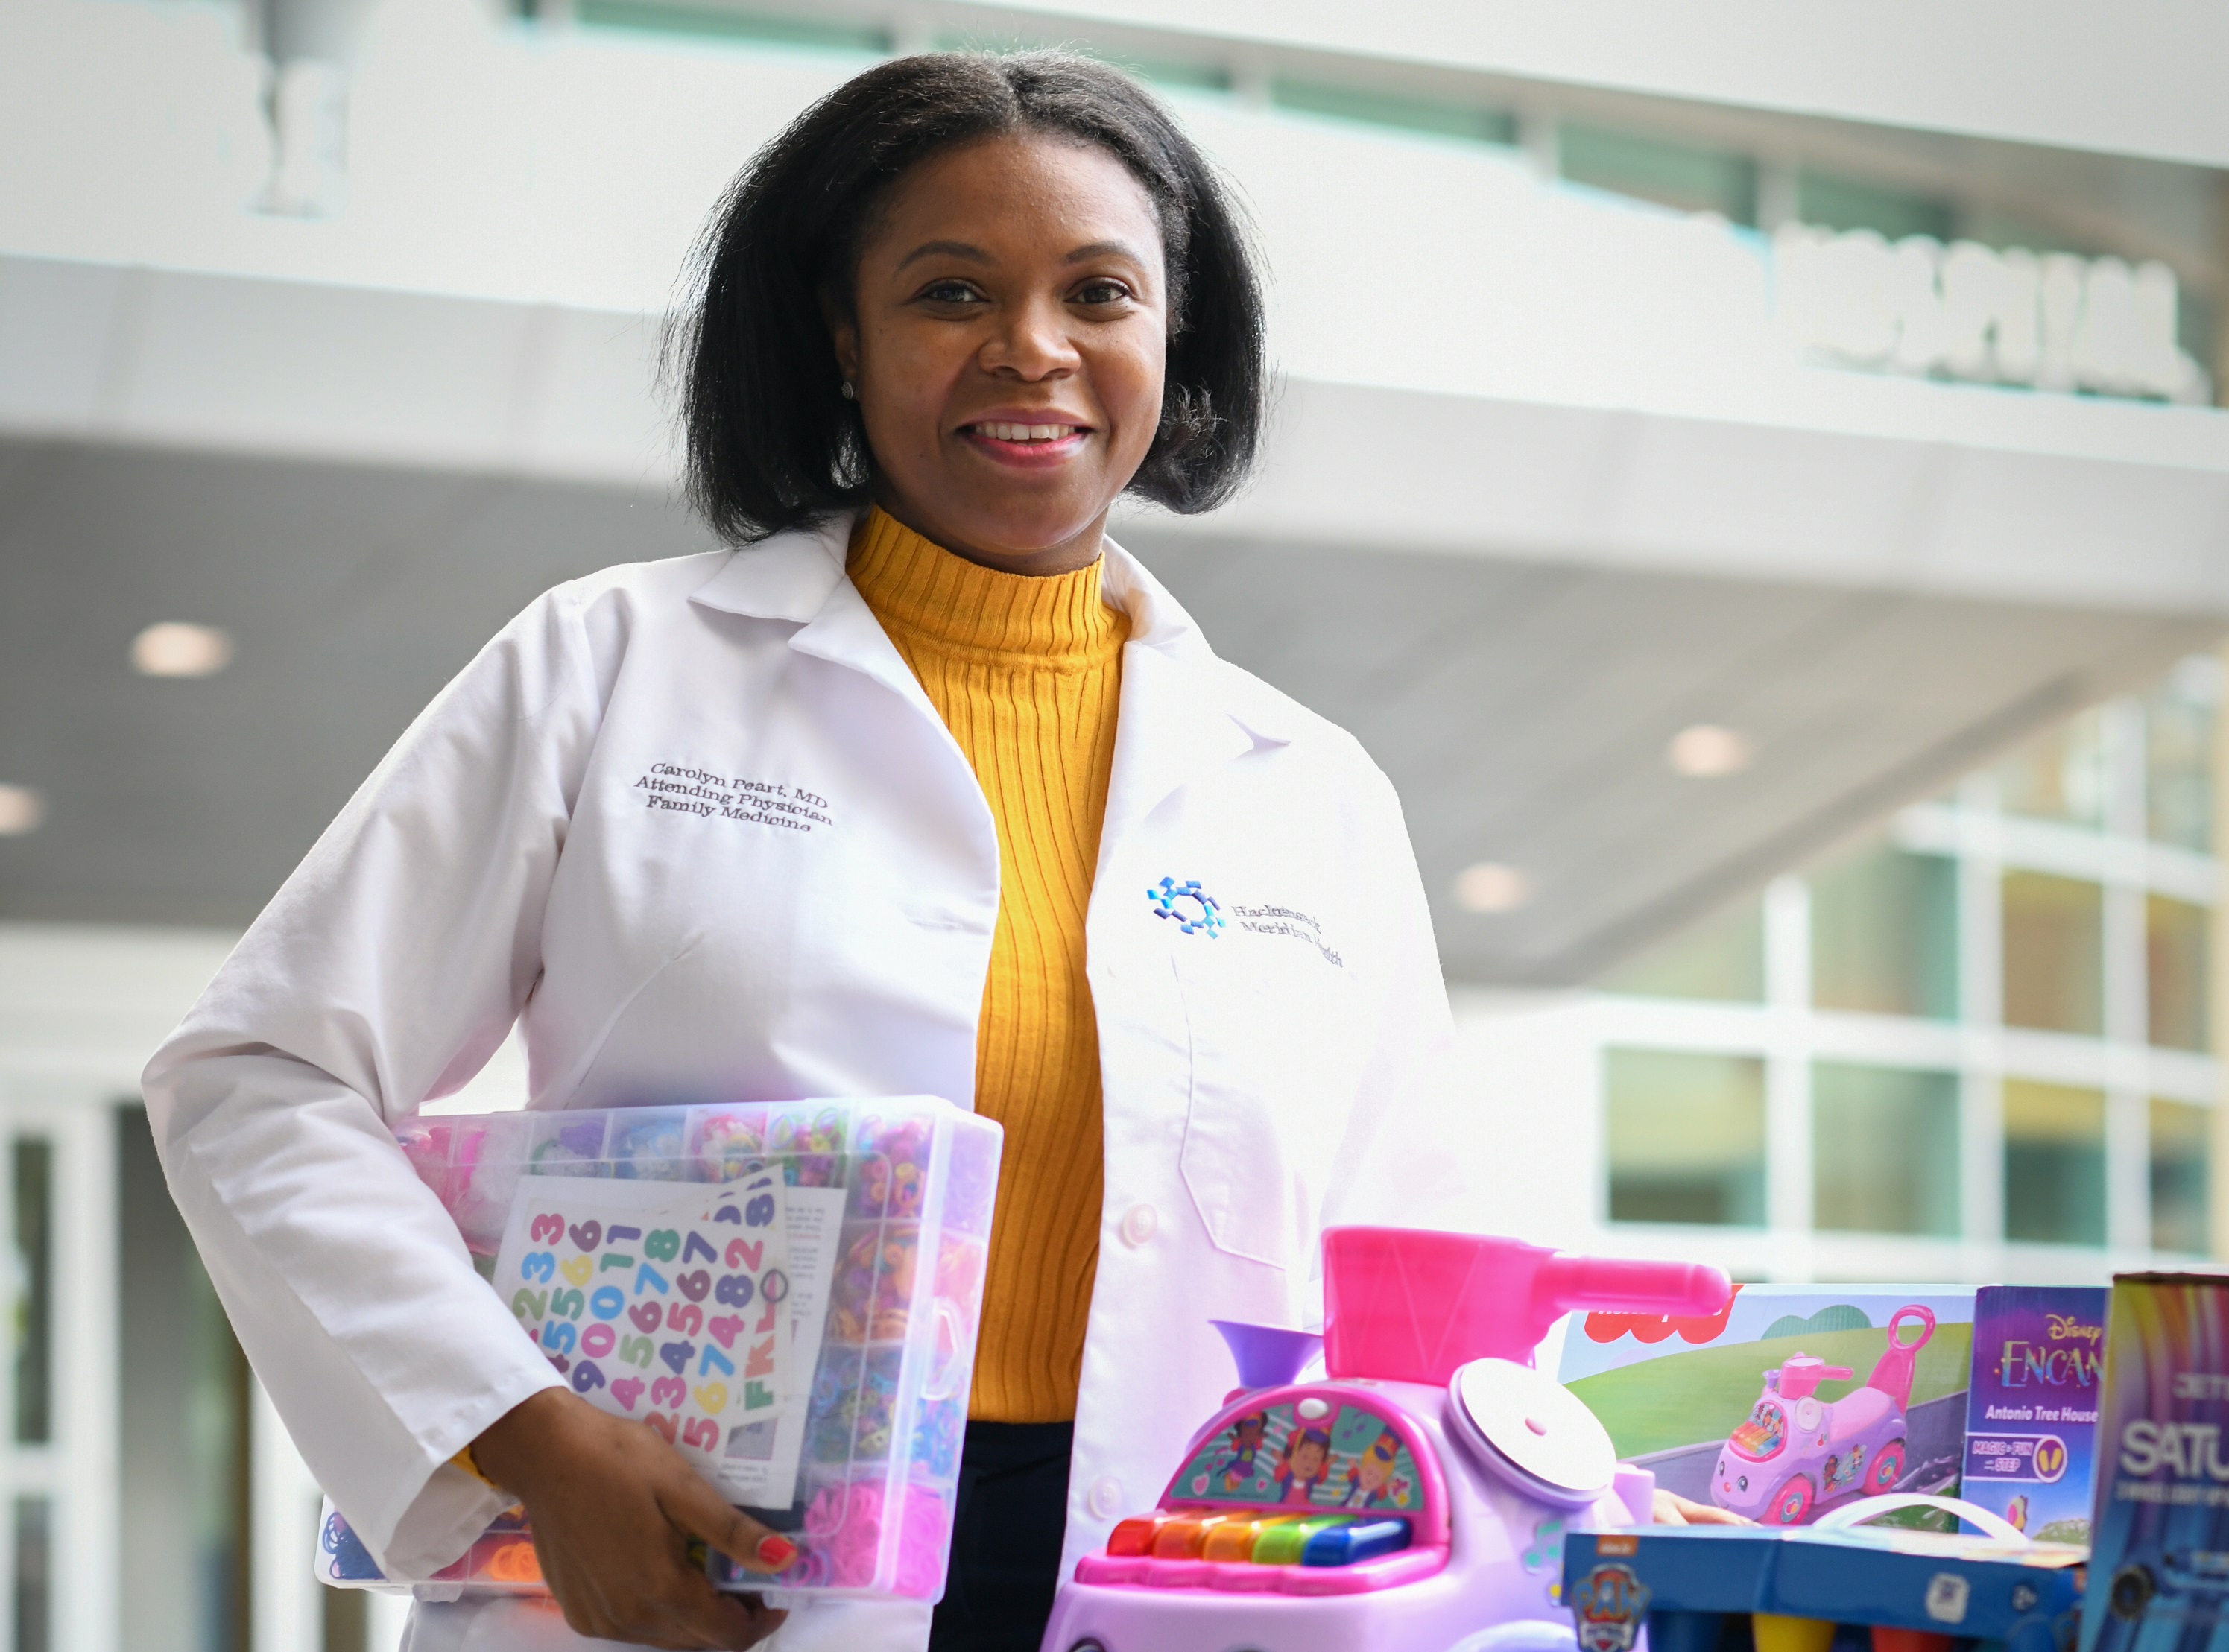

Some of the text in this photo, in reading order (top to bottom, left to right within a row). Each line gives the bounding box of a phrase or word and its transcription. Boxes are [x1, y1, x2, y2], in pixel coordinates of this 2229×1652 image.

[651, 763, 829, 808] Carolyn Peart, MD
[633, 776, 833, 826] Attending Physician
[646, 794, 812, 832] Family Medicine
[1985, 1405, 2099, 1422] Antonio Tree House
[1972, 1440, 2007, 1455] MAGIC
[1994, 1457, 2021, 1472] STEP
